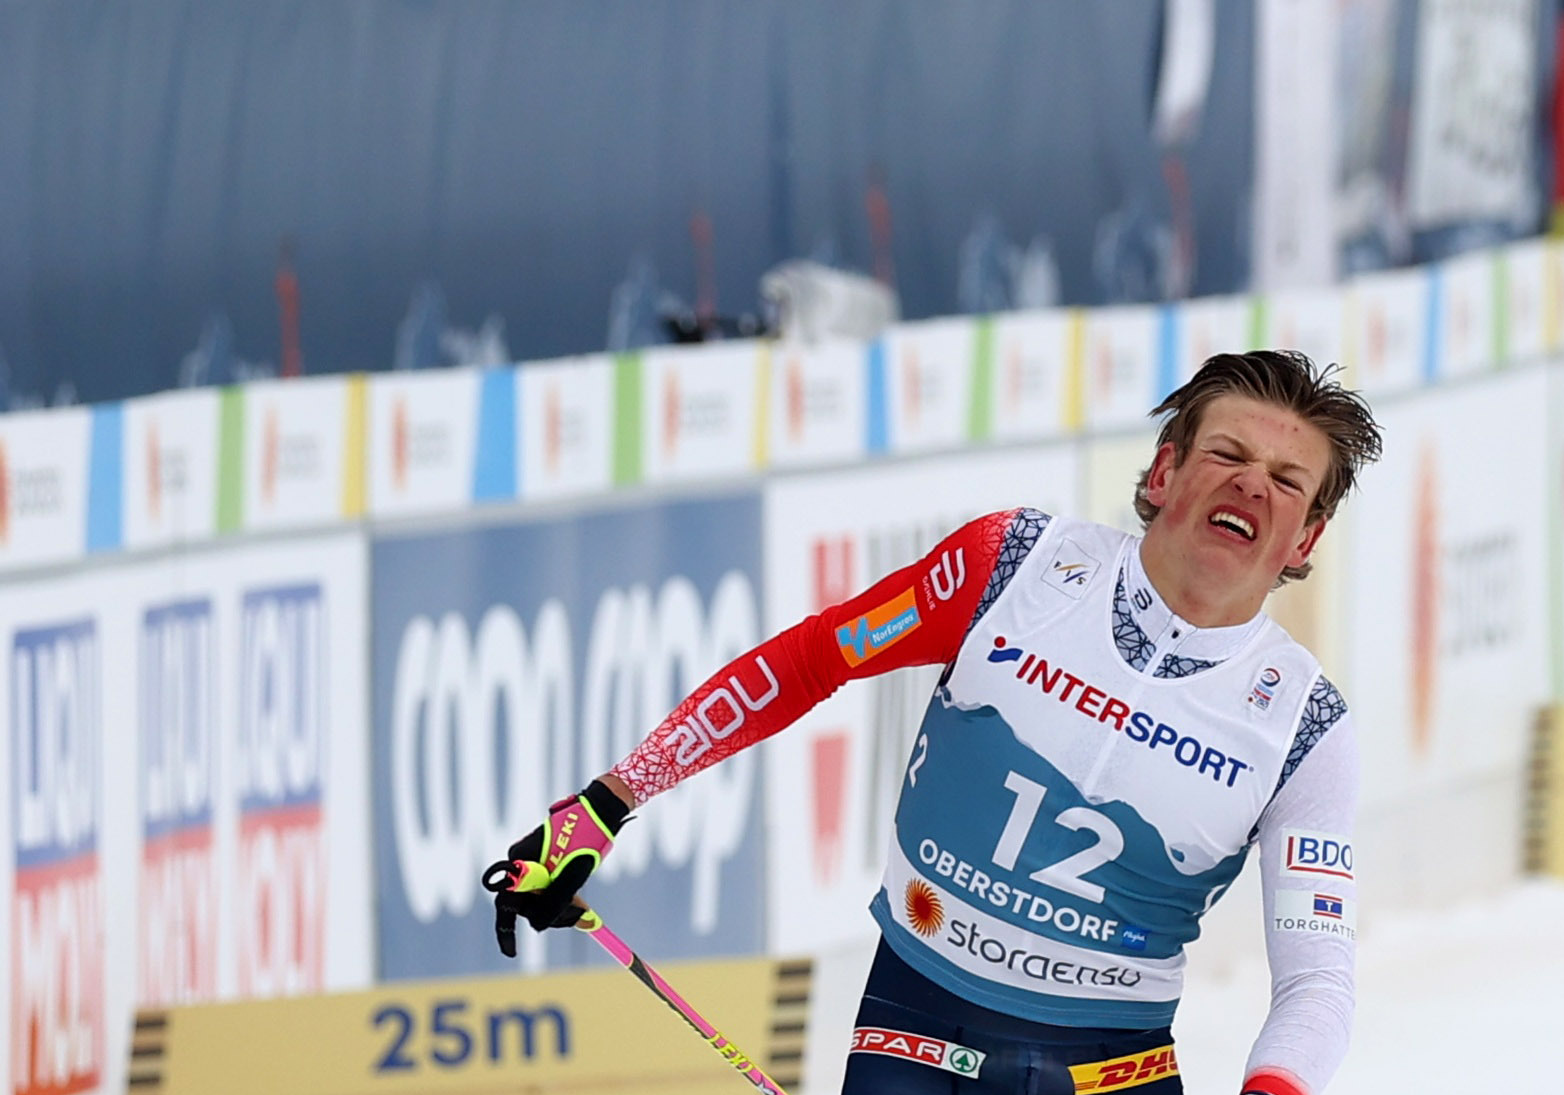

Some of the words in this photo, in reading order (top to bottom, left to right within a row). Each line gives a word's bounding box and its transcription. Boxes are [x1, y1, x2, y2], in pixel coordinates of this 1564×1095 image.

[872, 614, 914, 644] NorEngros
[1016, 654, 1248, 788] INTERSPORT
[550, 812, 579, 866] LEKI
[990, 769, 1125, 904] 12
[1298, 836, 1353, 871] BDO
[918, 838, 1119, 942] OBERSTDORF
[947, 919, 1142, 988] storaenso
[370, 998, 573, 1075] 25m
[850, 1032, 943, 1061] SPAR
